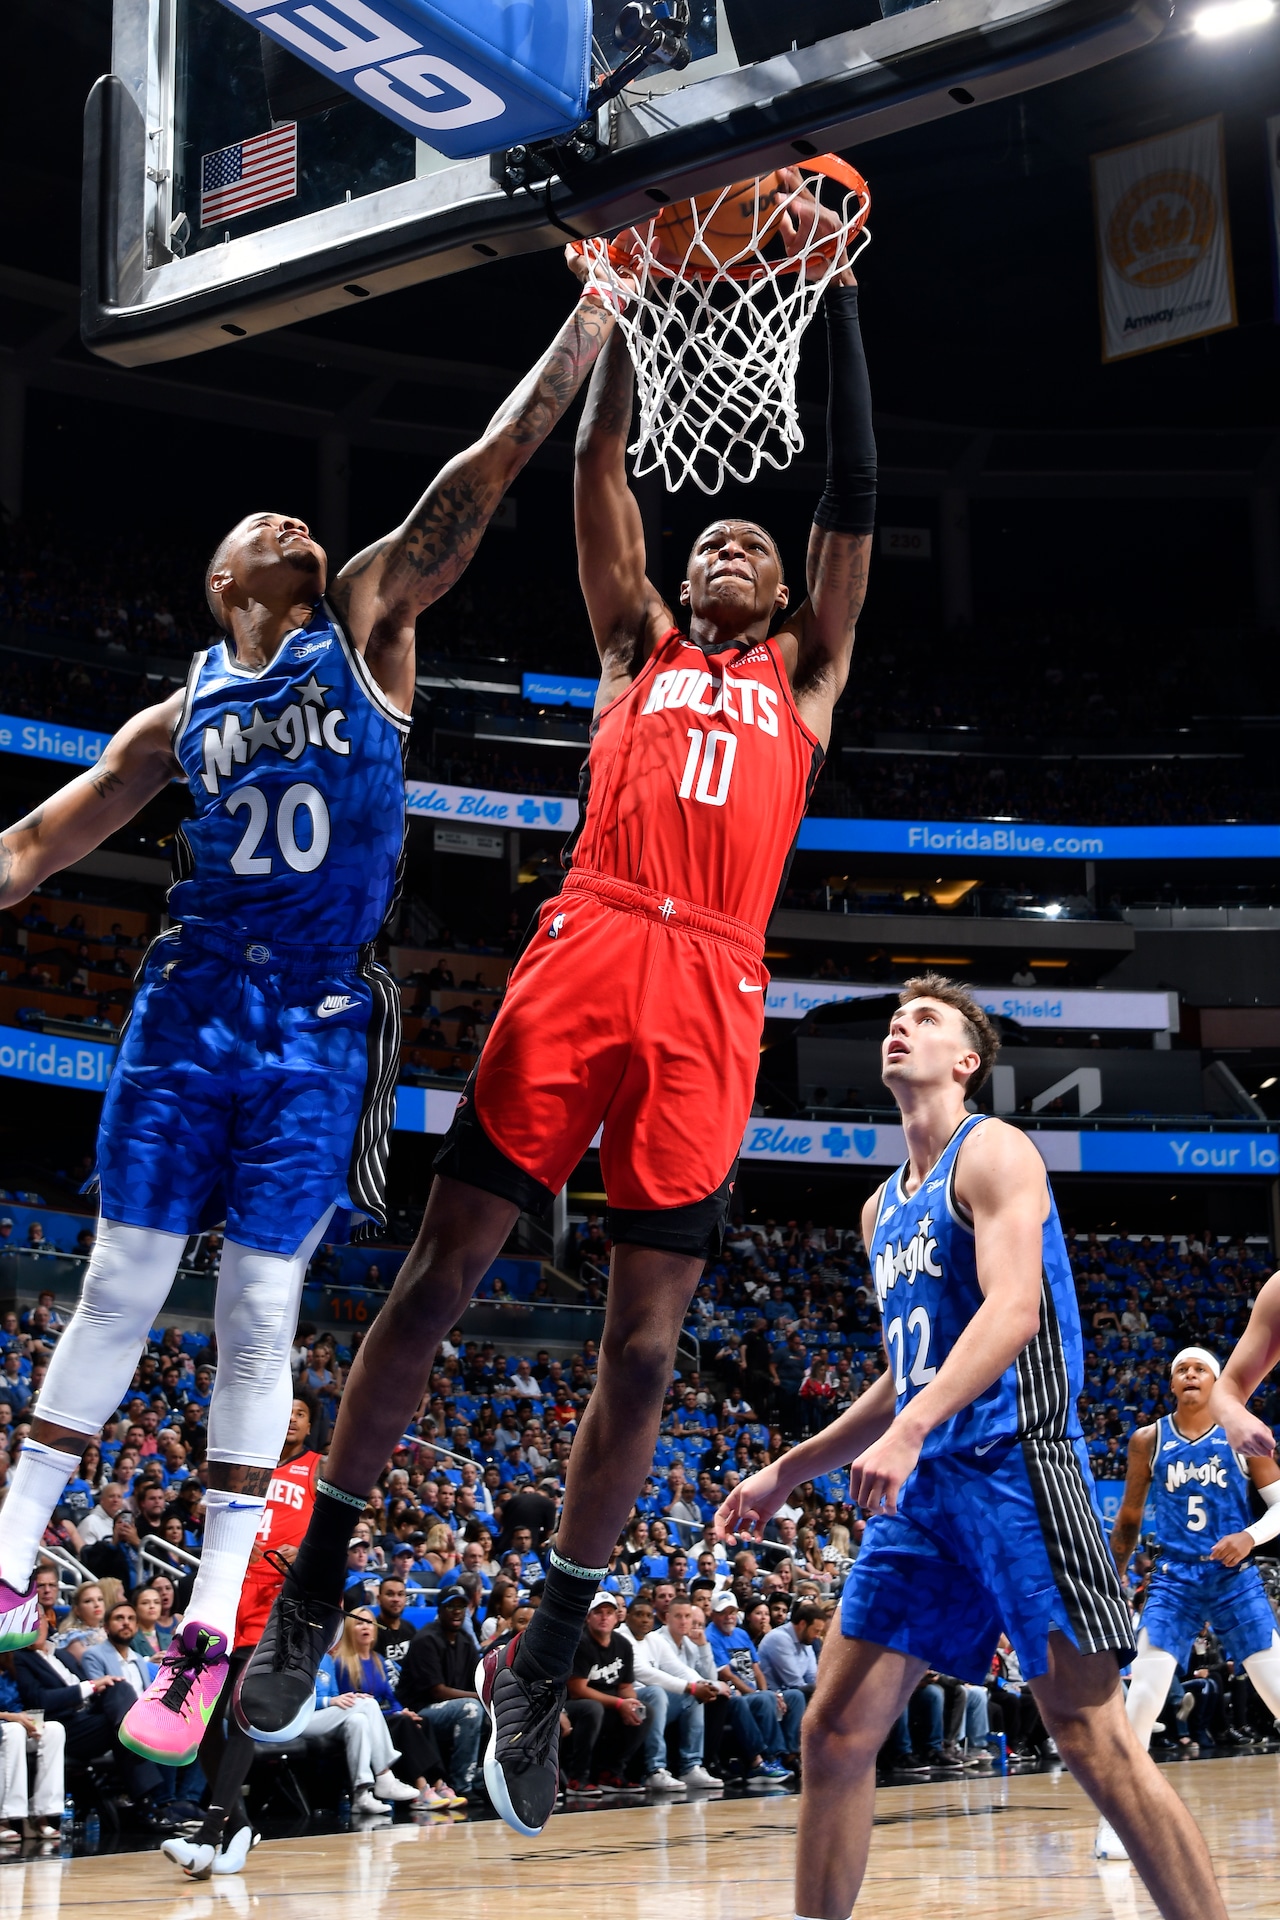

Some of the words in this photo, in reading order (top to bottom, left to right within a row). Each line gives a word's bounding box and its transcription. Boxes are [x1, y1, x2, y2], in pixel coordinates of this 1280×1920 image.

[228, 0, 506, 130] GE
[1123, 306, 1175, 332] Amway
[890, 533, 921, 549] 230
[22, 726, 102, 761] Shield
[678, 727, 738, 807] 10
[455, 795, 510, 819] Blue
[225, 782, 331, 875] 20
[908, 827, 1104, 853] FloridaBlue.com
[324, 995, 351, 1008] NIKE
[1002, 999, 1063, 1018] Shield
[748, 1125, 812, 1154] Blue
[1169, 1140, 1241, 1167] Your
[330, 1297, 368, 1322] 116
[887, 1306, 937, 1396] 22
[1186, 1495, 1207, 1532] 5
